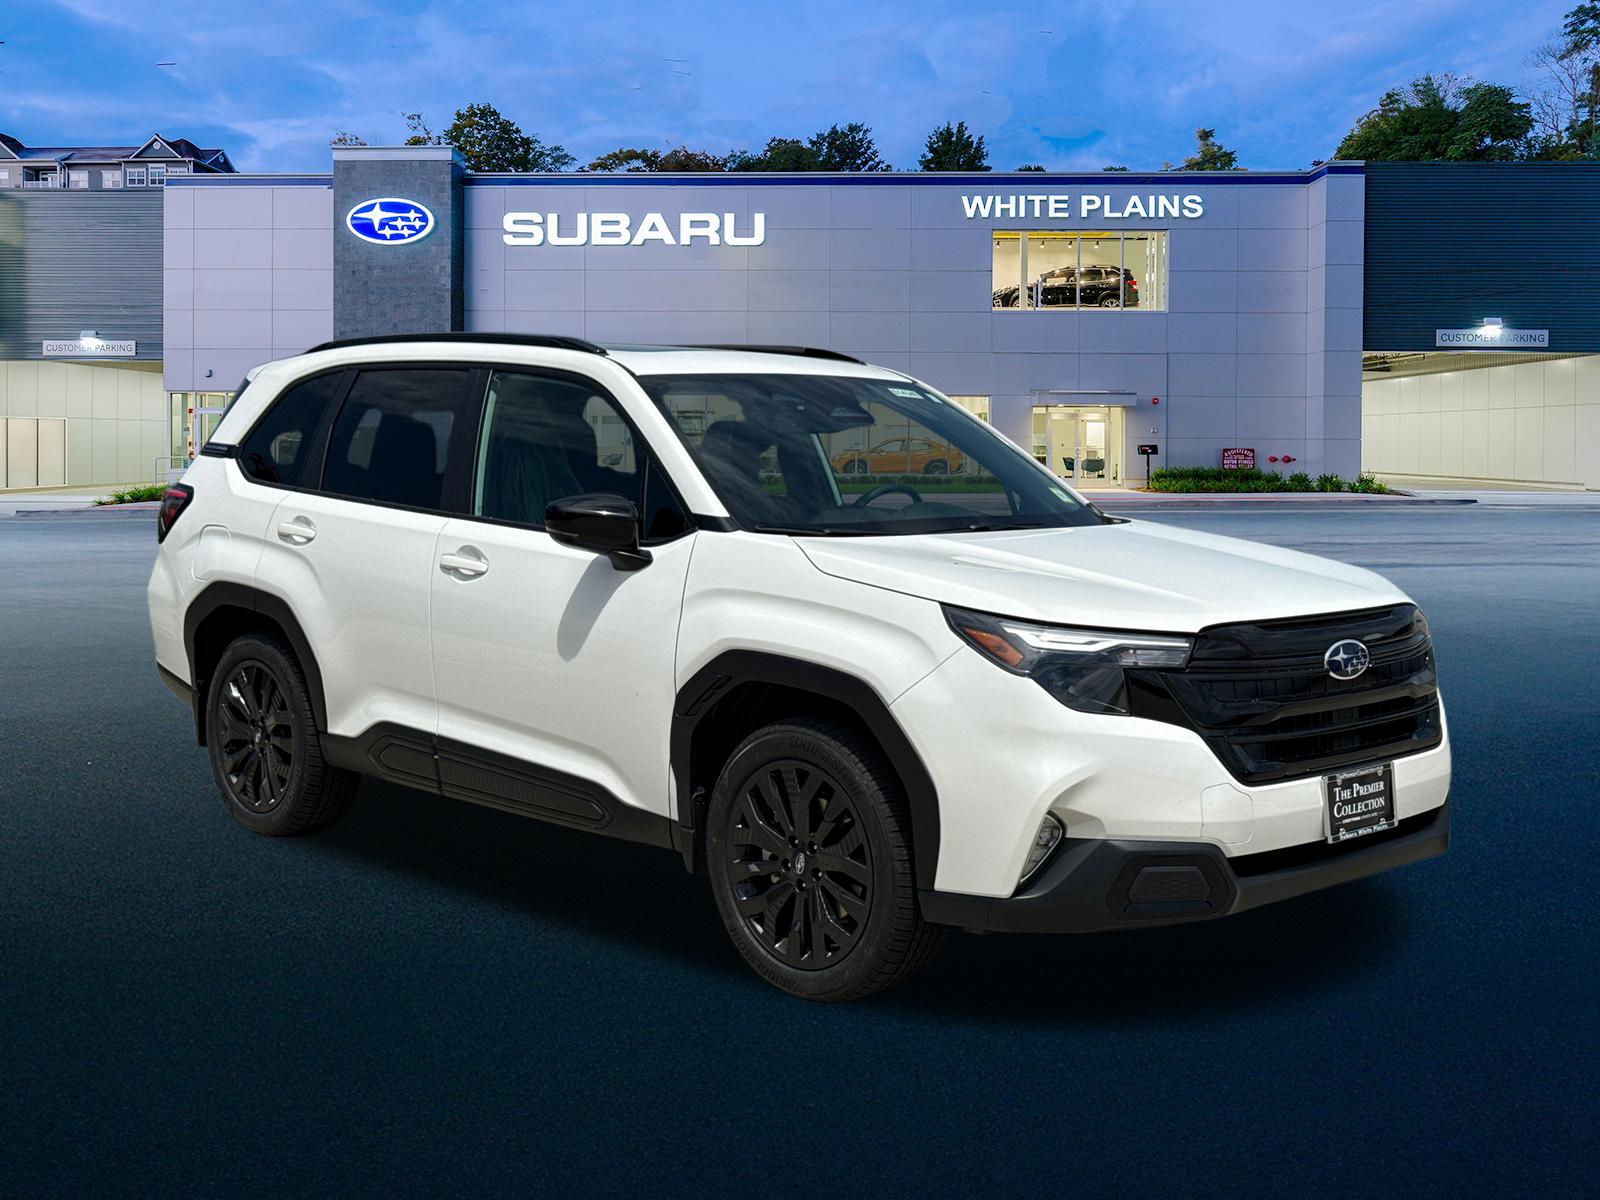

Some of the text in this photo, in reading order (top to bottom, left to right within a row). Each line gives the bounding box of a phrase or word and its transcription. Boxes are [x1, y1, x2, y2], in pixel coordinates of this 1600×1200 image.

[961, 194, 1204, 219] WHITE PLAINS
[502, 211, 766, 247] SUBARU
[45, 343, 133, 352] CUSTOMER PARKING
[1440, 333, 1545, 343] CUSTOMER PARKING
[1333, 781, 1385, 801] THE PREMIER
[1333, 796, 1385, 817] COLLECTION
